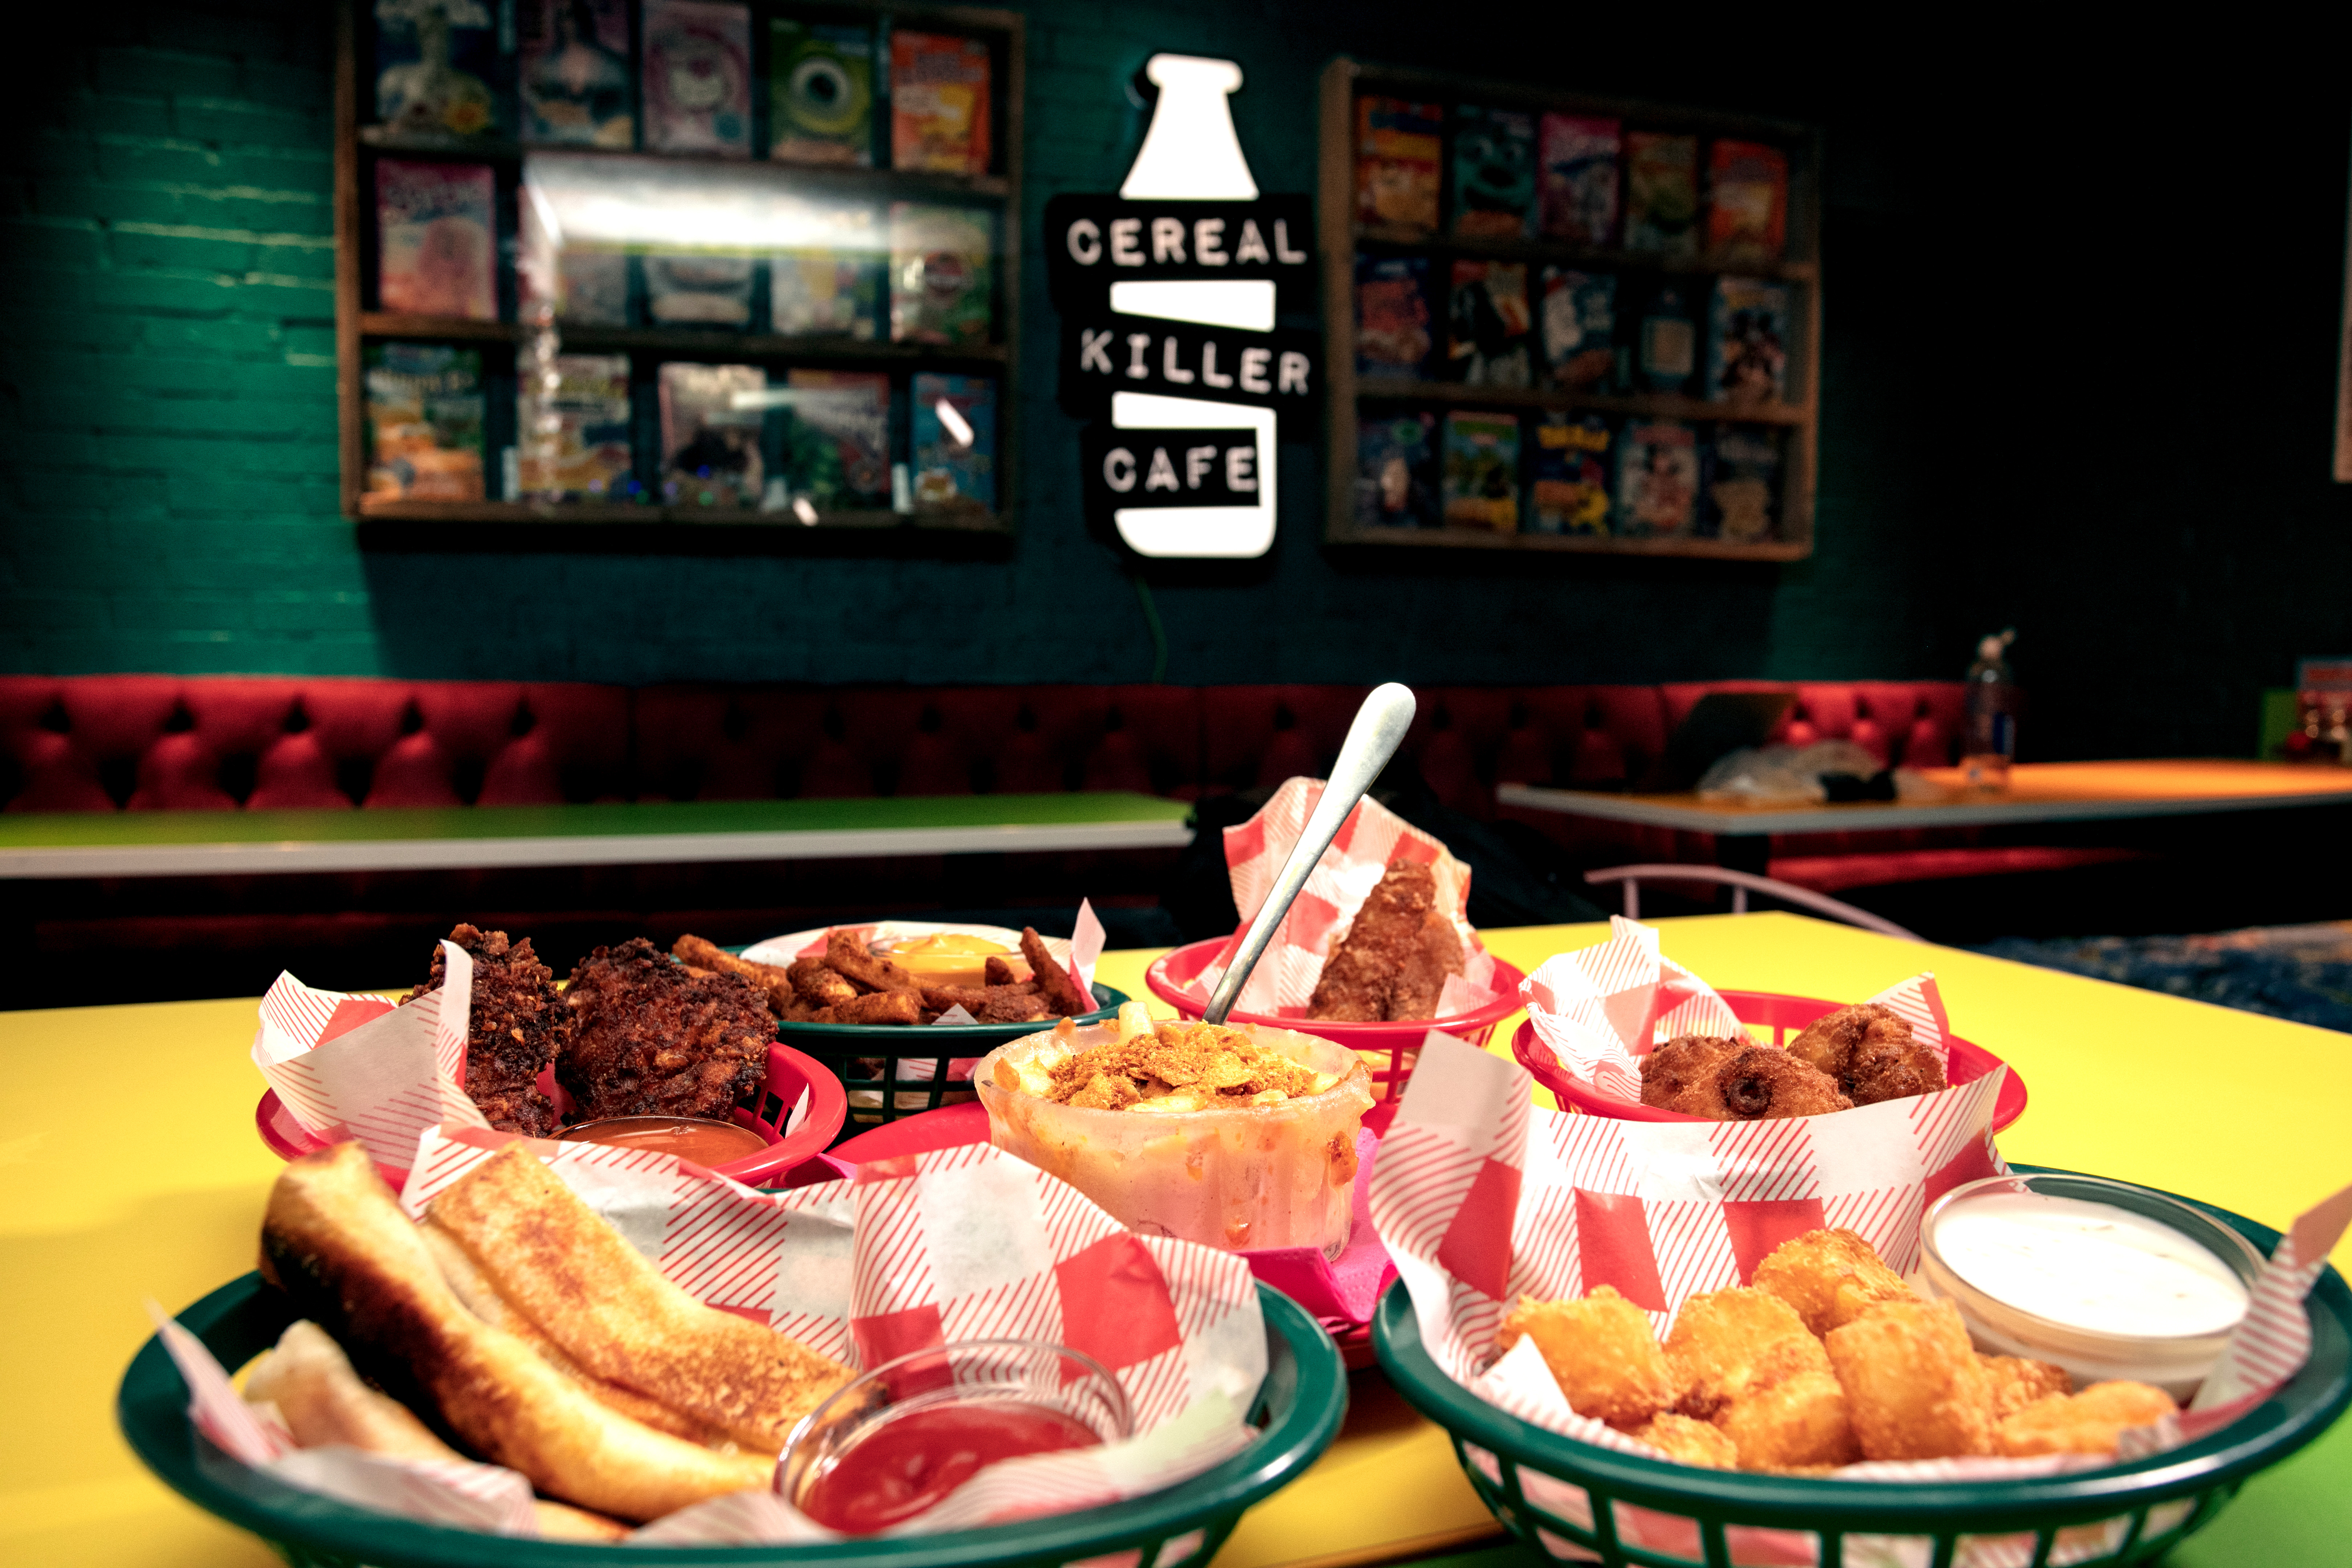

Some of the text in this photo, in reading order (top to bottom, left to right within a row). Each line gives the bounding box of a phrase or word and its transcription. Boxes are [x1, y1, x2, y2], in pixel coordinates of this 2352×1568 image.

[1067, 219, 1307, 266] CEREAL
[1081, 329, 1310, 395] KILLER
[1103, 446, 1257, 492] CAFE
